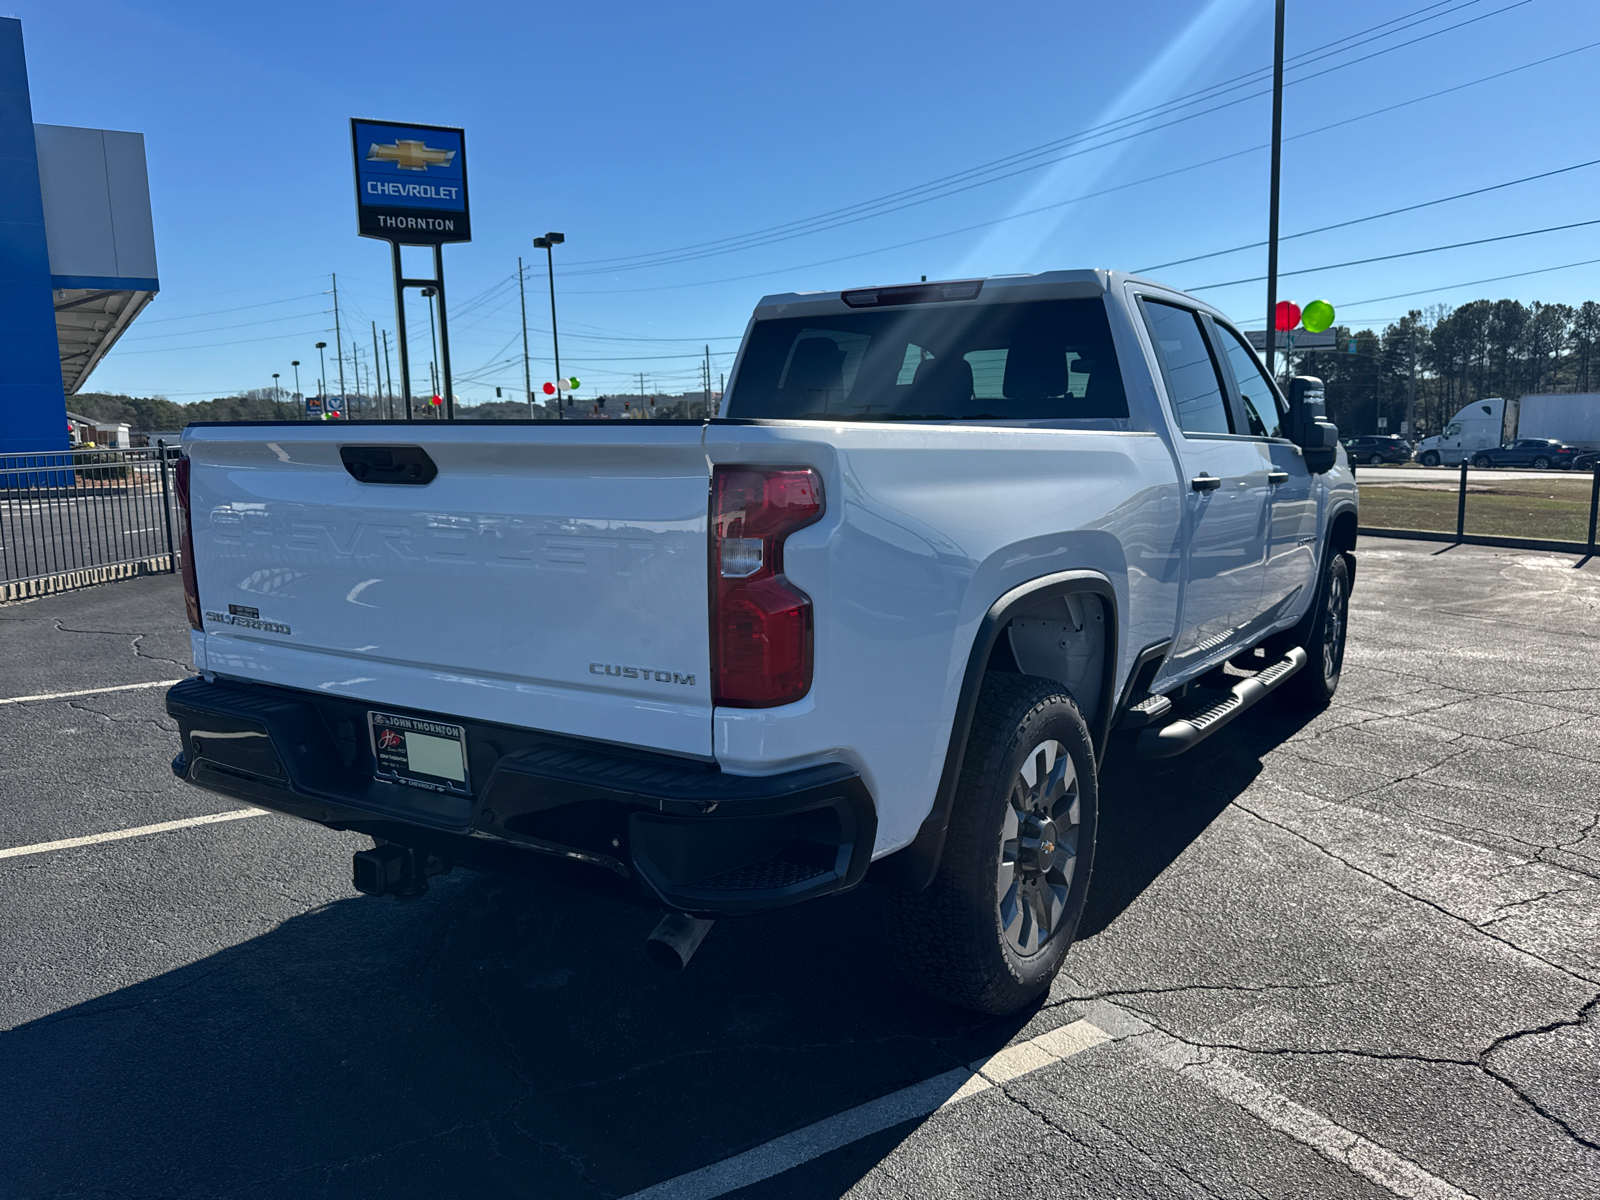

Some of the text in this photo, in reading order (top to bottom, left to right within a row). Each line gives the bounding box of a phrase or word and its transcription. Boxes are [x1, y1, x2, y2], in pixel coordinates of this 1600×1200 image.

[367, 181, 458, 200] CHEVROLET
[377, 215, 454, 231] THORNTON
[205, 610, 291, 635] SILVERADO
[588, 662, 696, 686] CUSTOM
[389, 716, 460, 737] JOHN THORNTON
[408, 780, 436, 791] CHEVROLET
